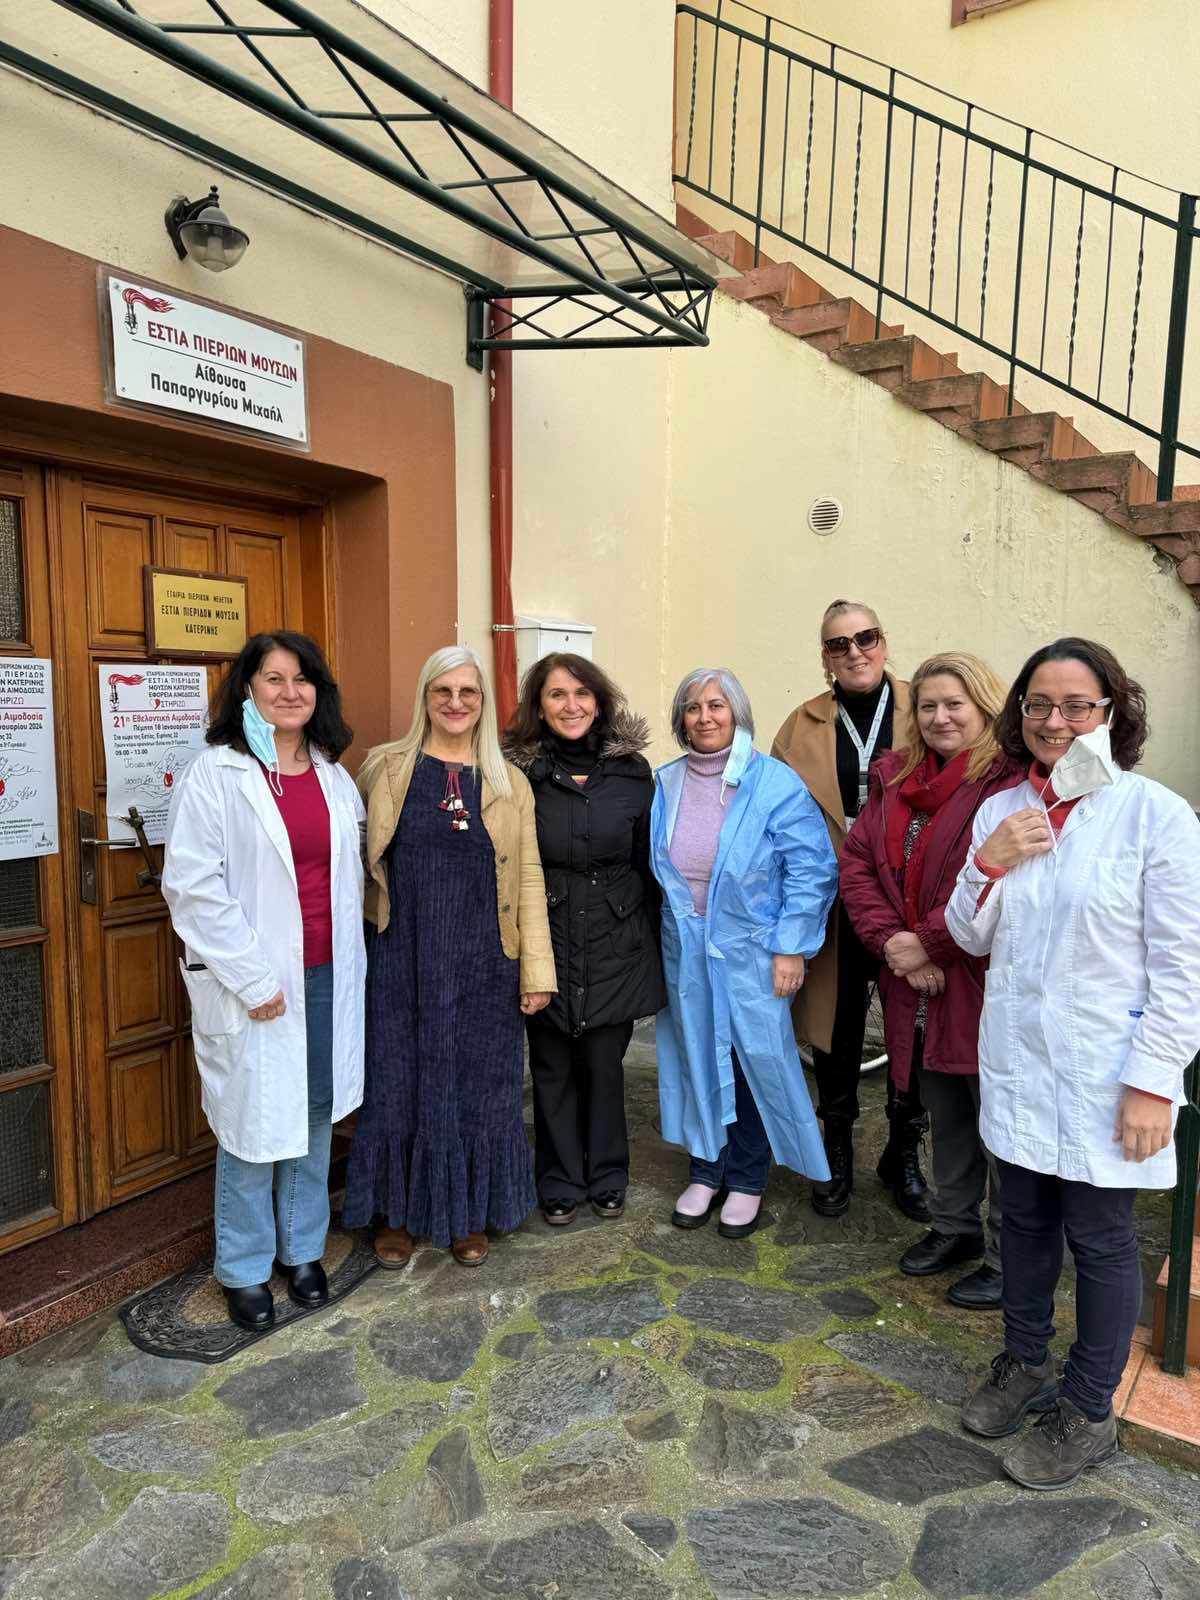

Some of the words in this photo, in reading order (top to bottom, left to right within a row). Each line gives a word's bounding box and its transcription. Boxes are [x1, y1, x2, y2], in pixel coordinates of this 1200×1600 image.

[148, 321, 189, 348] ΕΣΤΙΑ
[193, 334, 247, 365] ΠΙΕΡΙΩΝ
[251, 353, 297, 382] ΜΟΥΣΩΝ
[195, 363, 247, 392] Αίθουσα
[151, 373, 238, 410] Παπαργυρίου
[242, 398, 283, 423] Μιχαήλ
[161, 605, 179, 615] ΕΣΤΙΑ
[184, 607, 212, 618] ΠΙΕΡΙΔΩΝ
[216, 610, 239, 620] ΜΟΥΣΩΝ
[185, 624, 218, 636] ΚΑΤΕΡΙΝΗΣ
[4, 712, 43, 722] Αιμοδοσία
